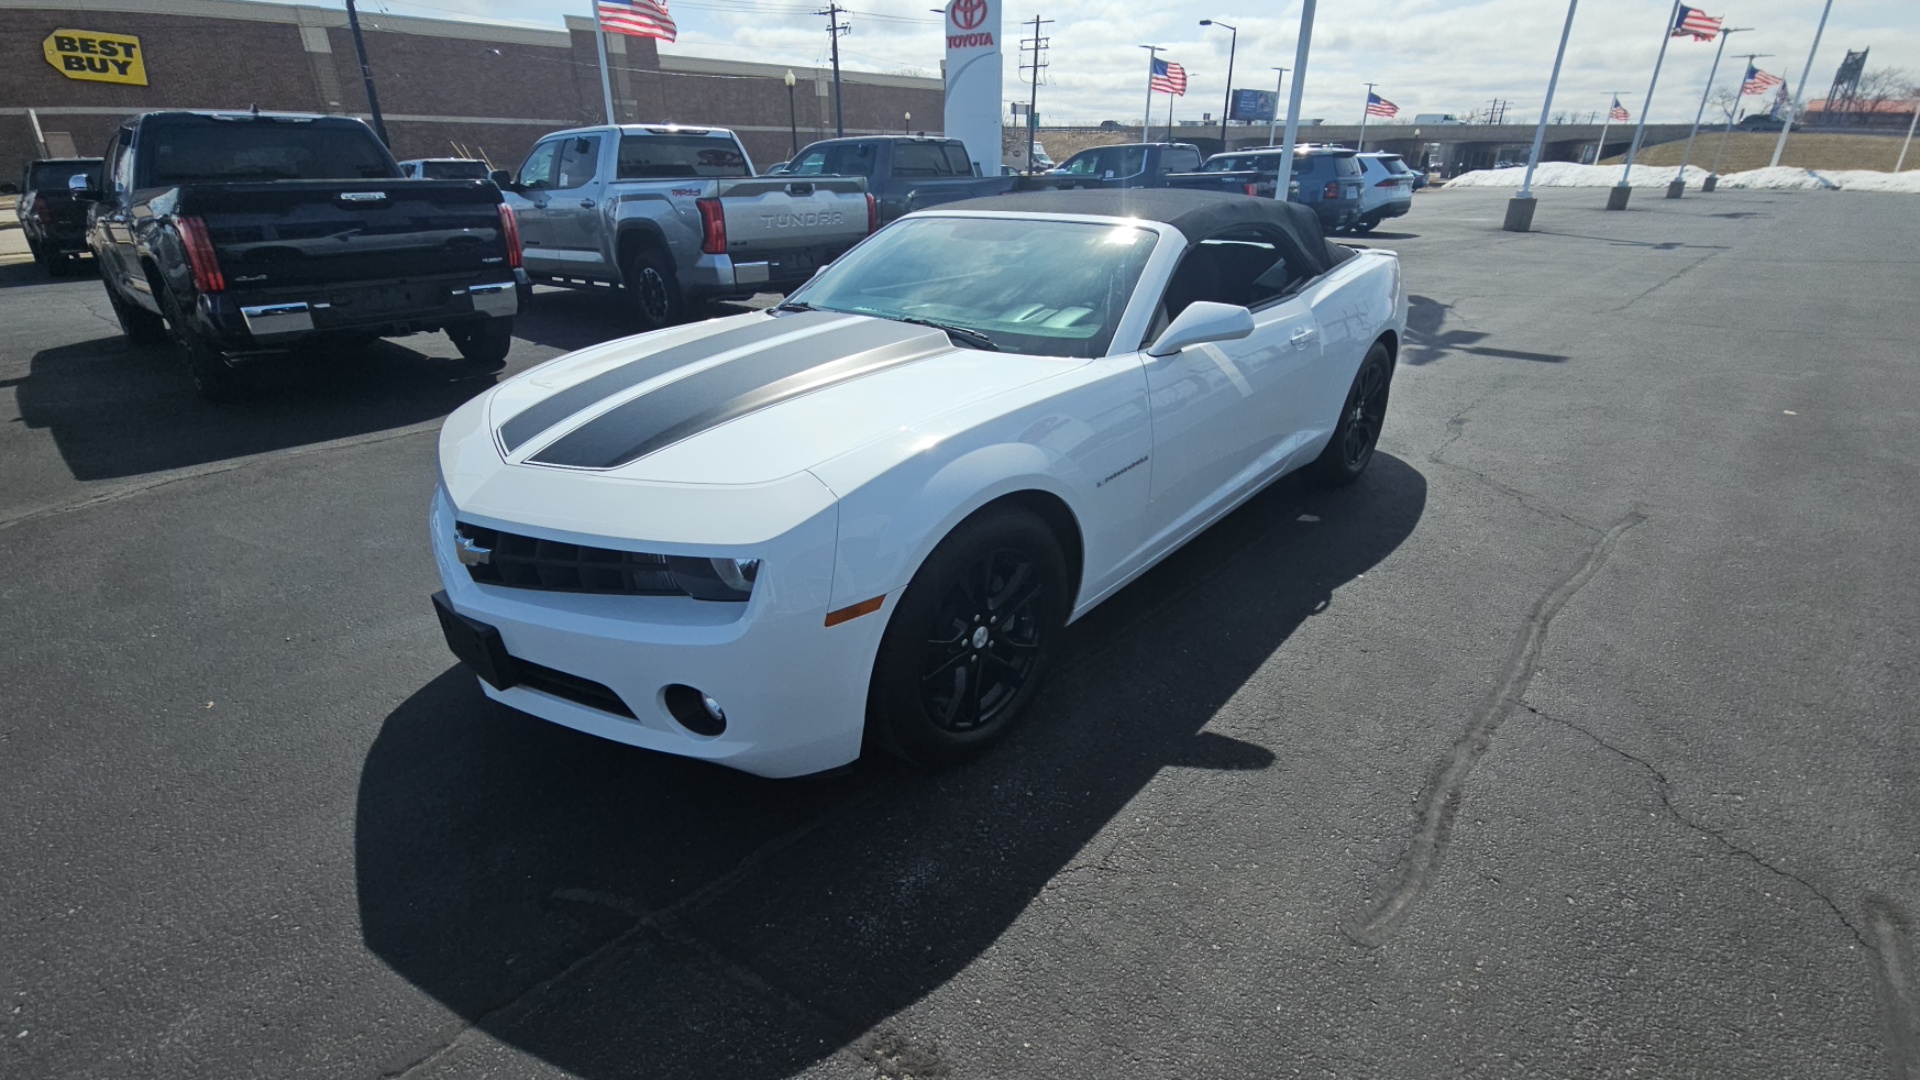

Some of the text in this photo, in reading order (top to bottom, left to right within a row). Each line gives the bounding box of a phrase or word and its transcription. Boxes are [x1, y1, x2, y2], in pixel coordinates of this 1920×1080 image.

[54, 35, 137, 59] BEST
[946, 32, 994, 49] TOYOTA
[62, 54, 133, 76] BUY
[760, 211, 844, 229] TUNDRA
